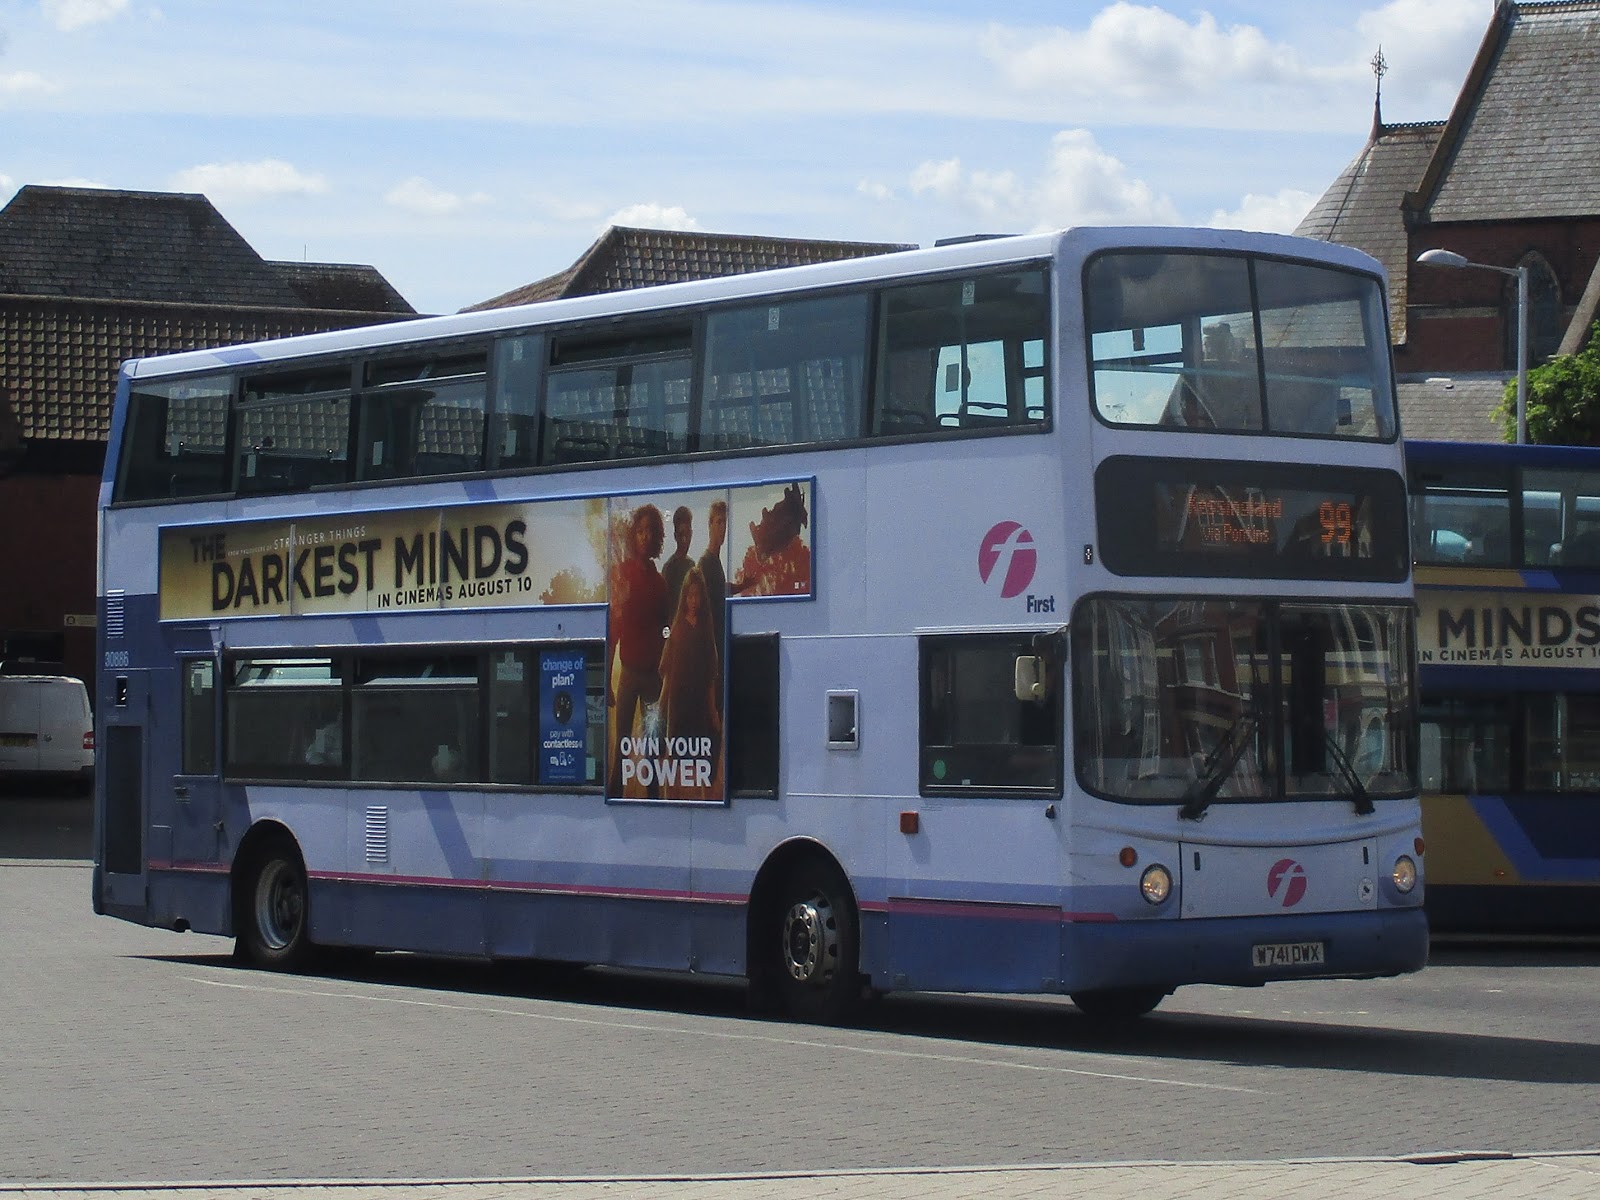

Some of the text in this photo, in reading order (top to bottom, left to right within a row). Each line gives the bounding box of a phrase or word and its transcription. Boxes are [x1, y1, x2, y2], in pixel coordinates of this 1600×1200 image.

[1319, 501, 1351, 544] 99
[190, 532, 226, 563] THE
[273, 532, 325, 551] STRANGER
[329, 525, 366, 541] THINGS
[212, 520, 529, 611] DARKEST MINDS
[377, 576, 532, 608] IN CINEMAS AUGUST 10
[1026, 594, 1055, 613] First
[1438, 605, 1600, 648] MINDS
[542, 657, 584, 673] change of
[1440, 649, 1513, 662] CINEMAS
[1520, 647, 1584, 660] AUGUST
[551, 673, 575, 689] plan?
[543, 739, 578, 749] contactless
[549, 728, 574, 740] pay with
[620, 736, 712, 757] OWN YOUR
[621, 758, 712, 787] POWER
